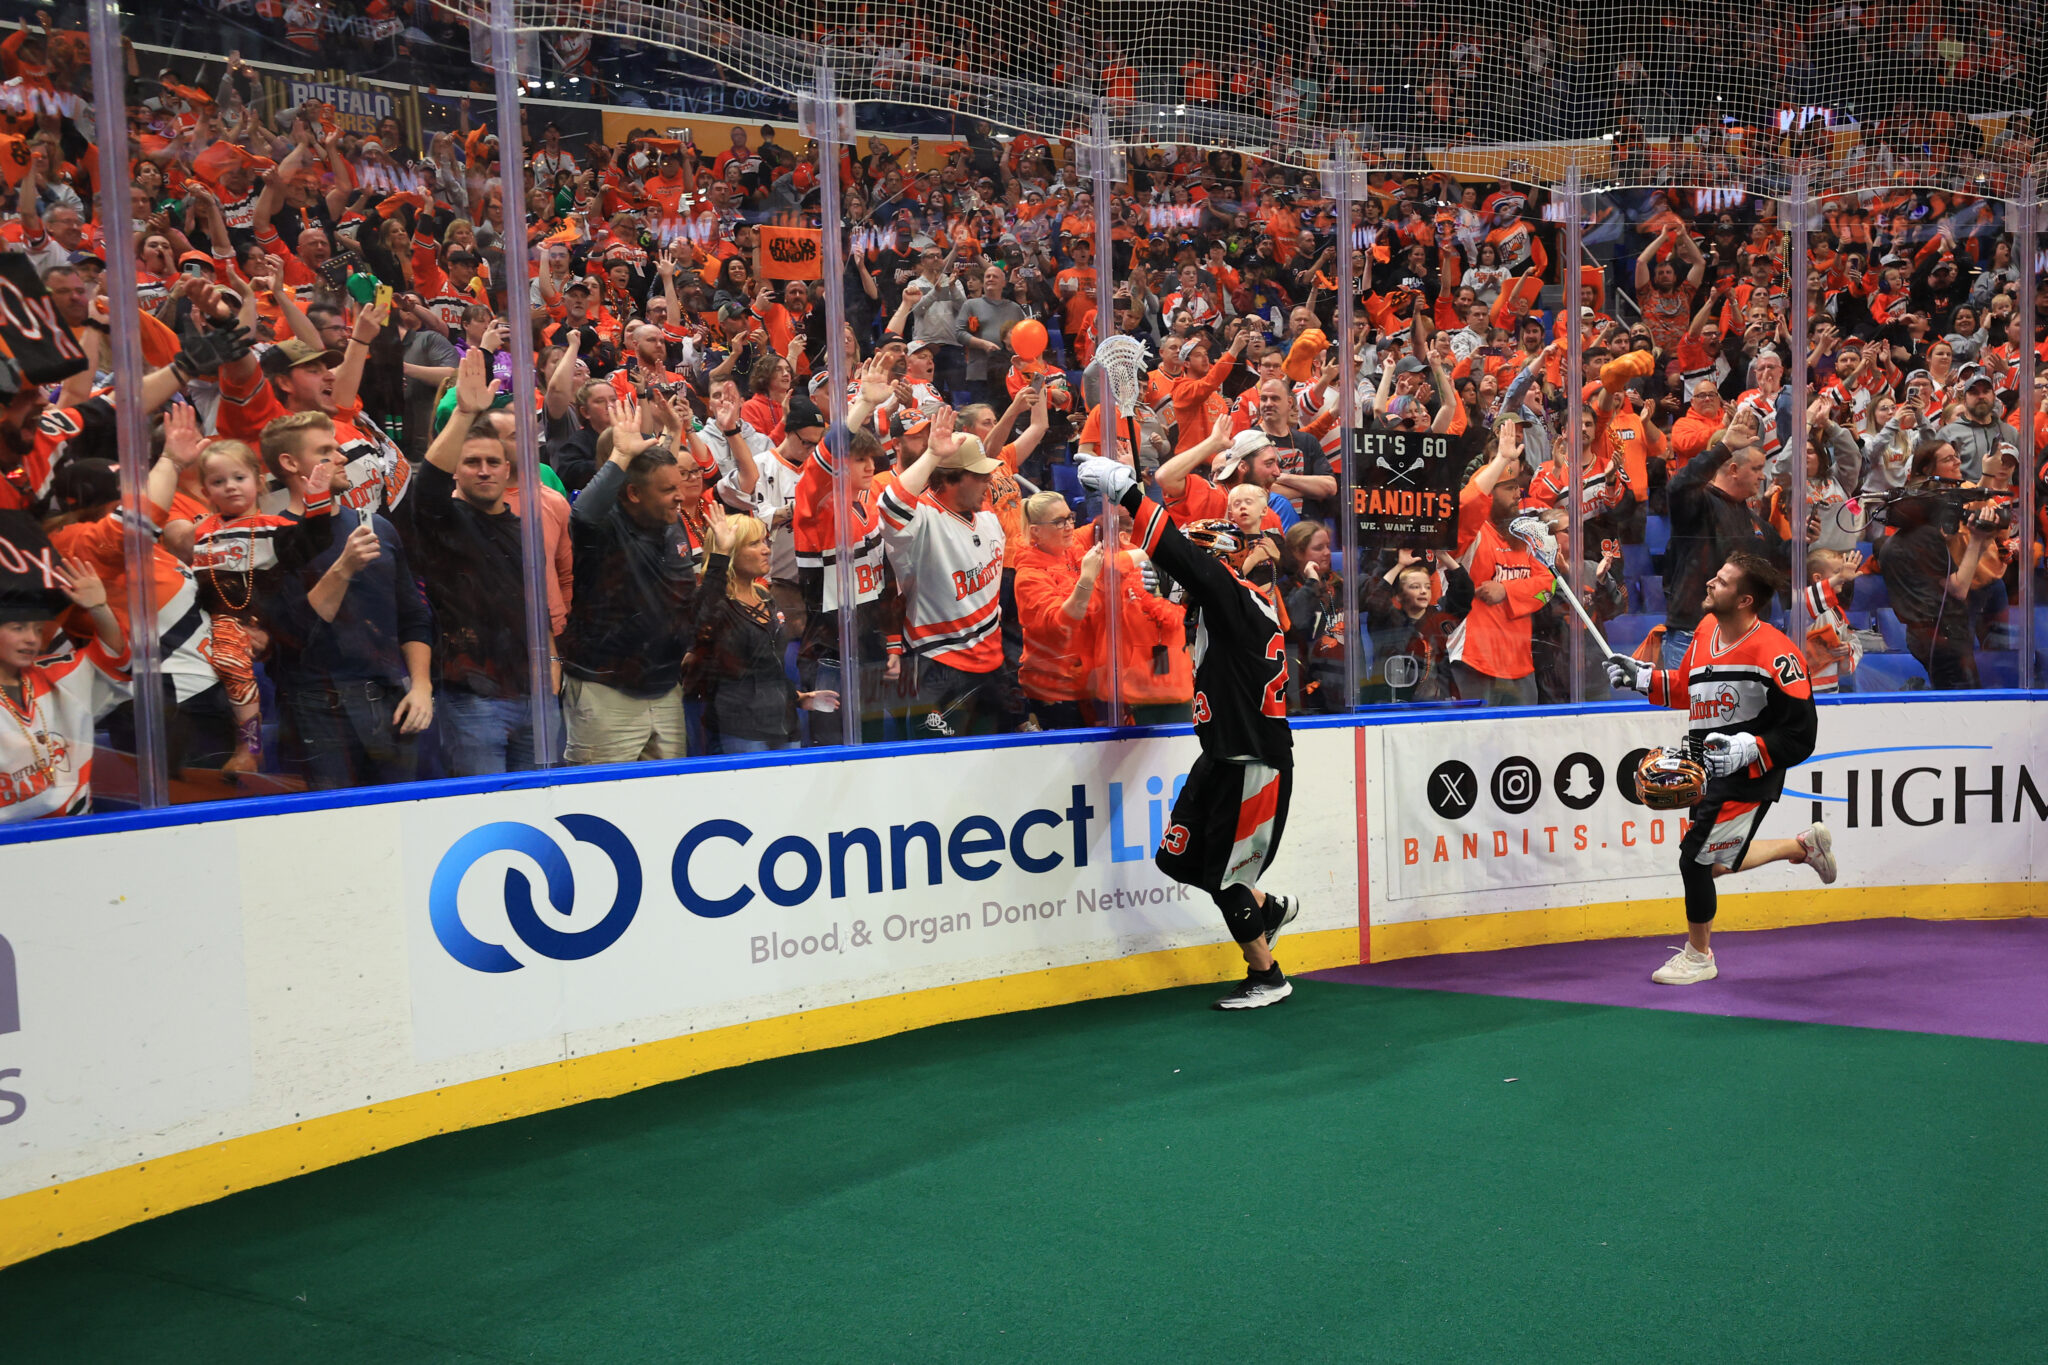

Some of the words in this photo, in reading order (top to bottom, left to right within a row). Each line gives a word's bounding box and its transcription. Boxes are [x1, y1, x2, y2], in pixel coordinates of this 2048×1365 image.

[1354, 434, 1406, 455] LET'S
[1422, 437, 1447, 459] GO
[1353, 488, 1453, 519] BANDITS
[1360, 521, 1381, 532] WE.
[1390, 522, 1417, 534] WANT.
[1420, 522, 1438, 534] SIX.
[750, 921, 840, 965] Blood
[849, 919, 874, 948] &
[882, 911, 971, 945] Organ
[981, 895, 1067, 928] Donor
[1076, 881, 1192, 914] Network
